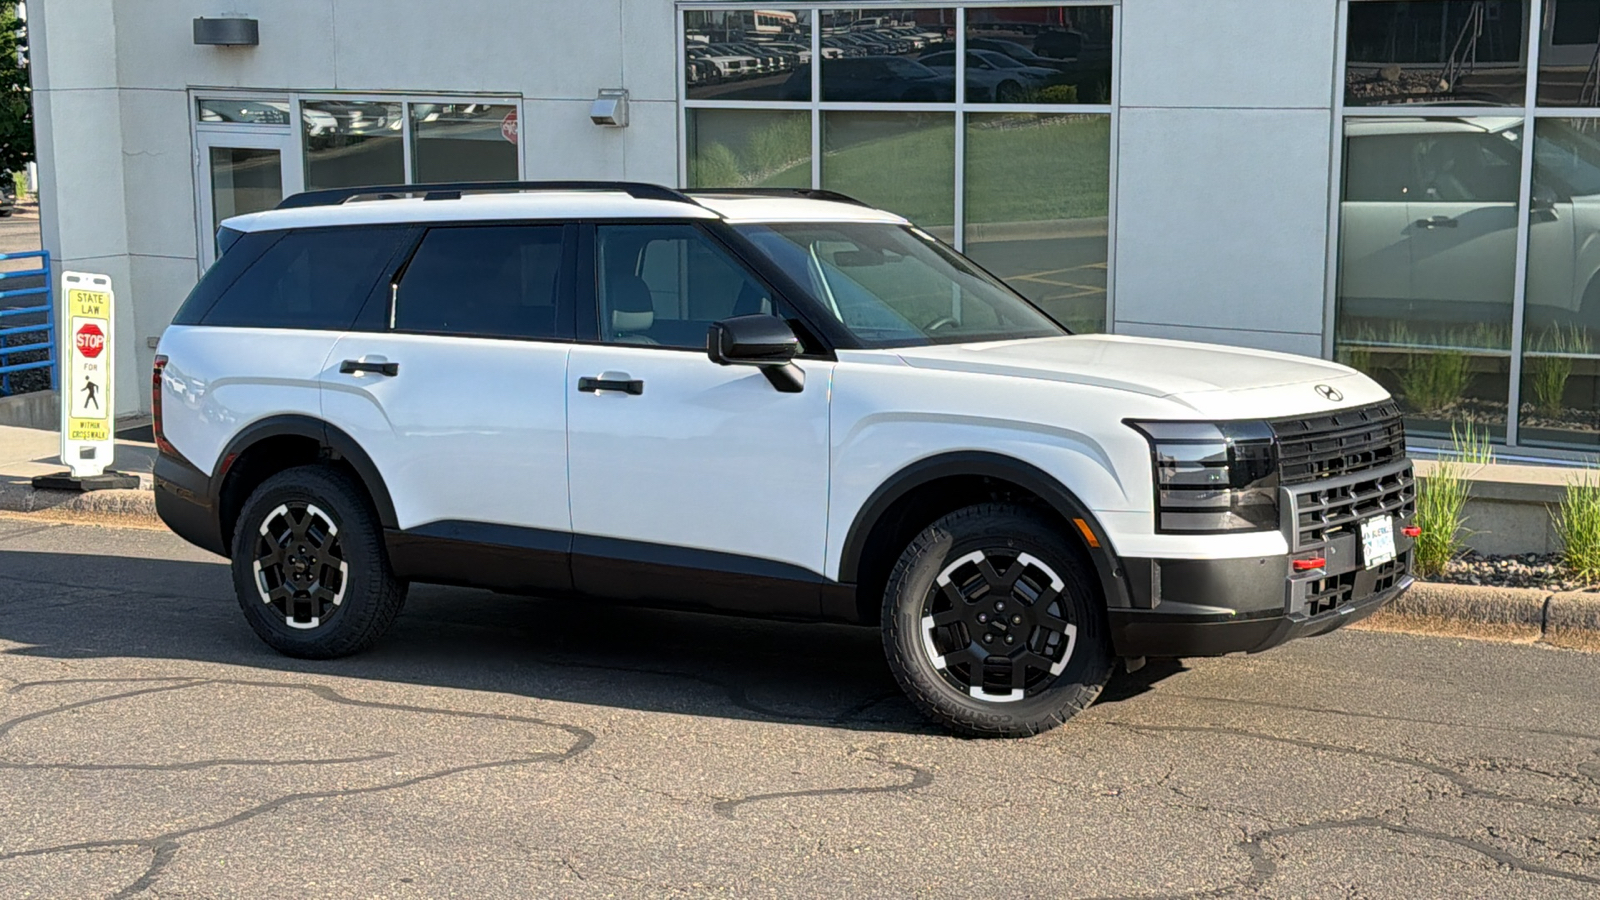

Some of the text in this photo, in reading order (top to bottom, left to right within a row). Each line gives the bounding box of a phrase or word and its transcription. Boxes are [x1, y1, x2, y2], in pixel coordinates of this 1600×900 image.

[77, 293, 104, 304] STATE
[81, 305, 99, 314] LAW
[77, 333, 104, 348] STOP
[83, 363, 98, 371] FOR
[80, 421, 100, 429] WITHIN
[72, 431, 105, 439] CROSSWALK
